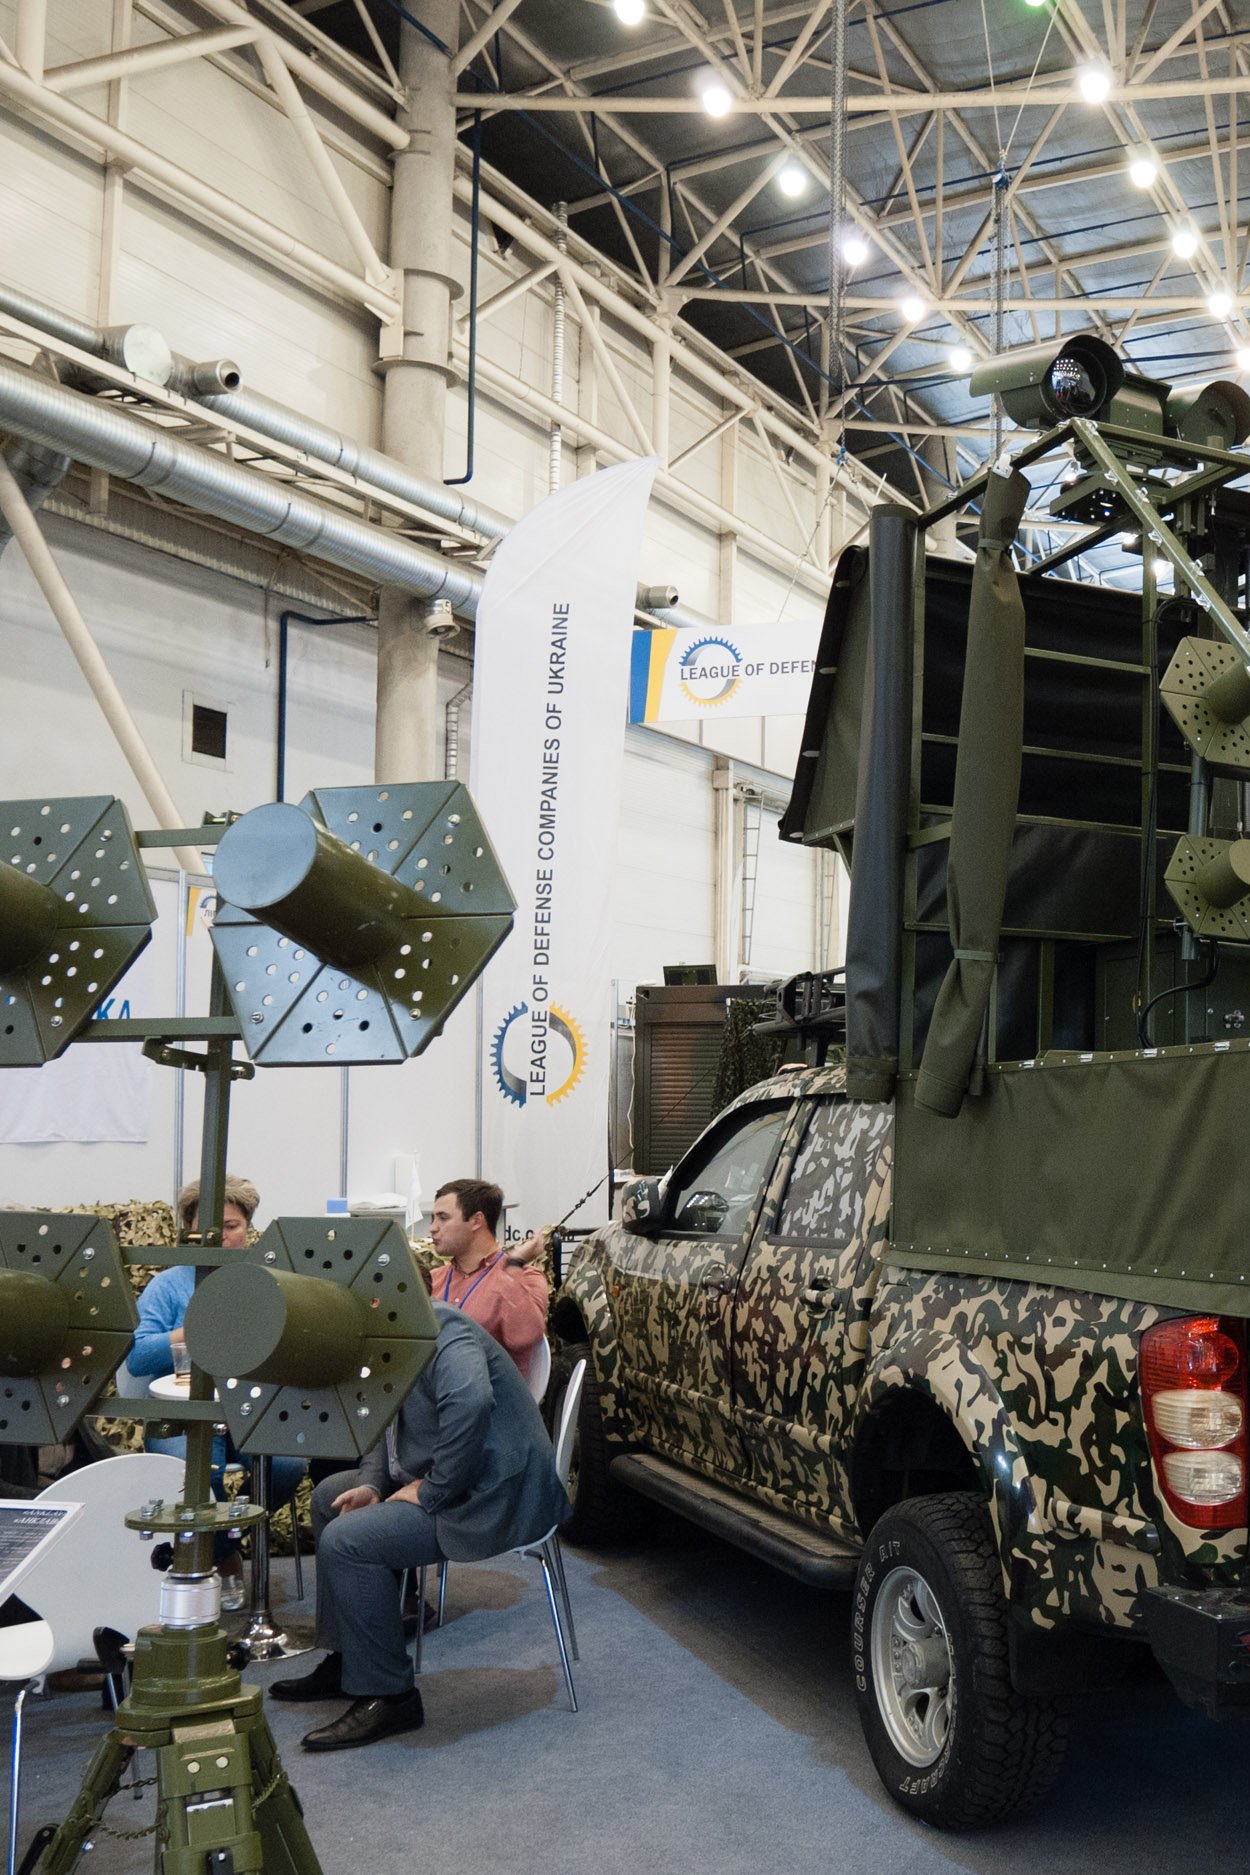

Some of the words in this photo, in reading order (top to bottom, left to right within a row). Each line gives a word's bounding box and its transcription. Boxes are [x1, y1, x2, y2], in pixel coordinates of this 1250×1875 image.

[547, 603, 570, 695] UKRAINE
[680, 664, 740, 681] LEAGUE
[744, 663, 765, 676] OF
[545, 702, 562, 730] OF
[537, 738, 561, 861] COMPANIES
[533, 868, 553, 966] DEFENSE
[532, 973, 549, 1002] OF
[530, 1010, 548, 1096] LEAGUE
[854, 1561, 876, 1692] COURSER
